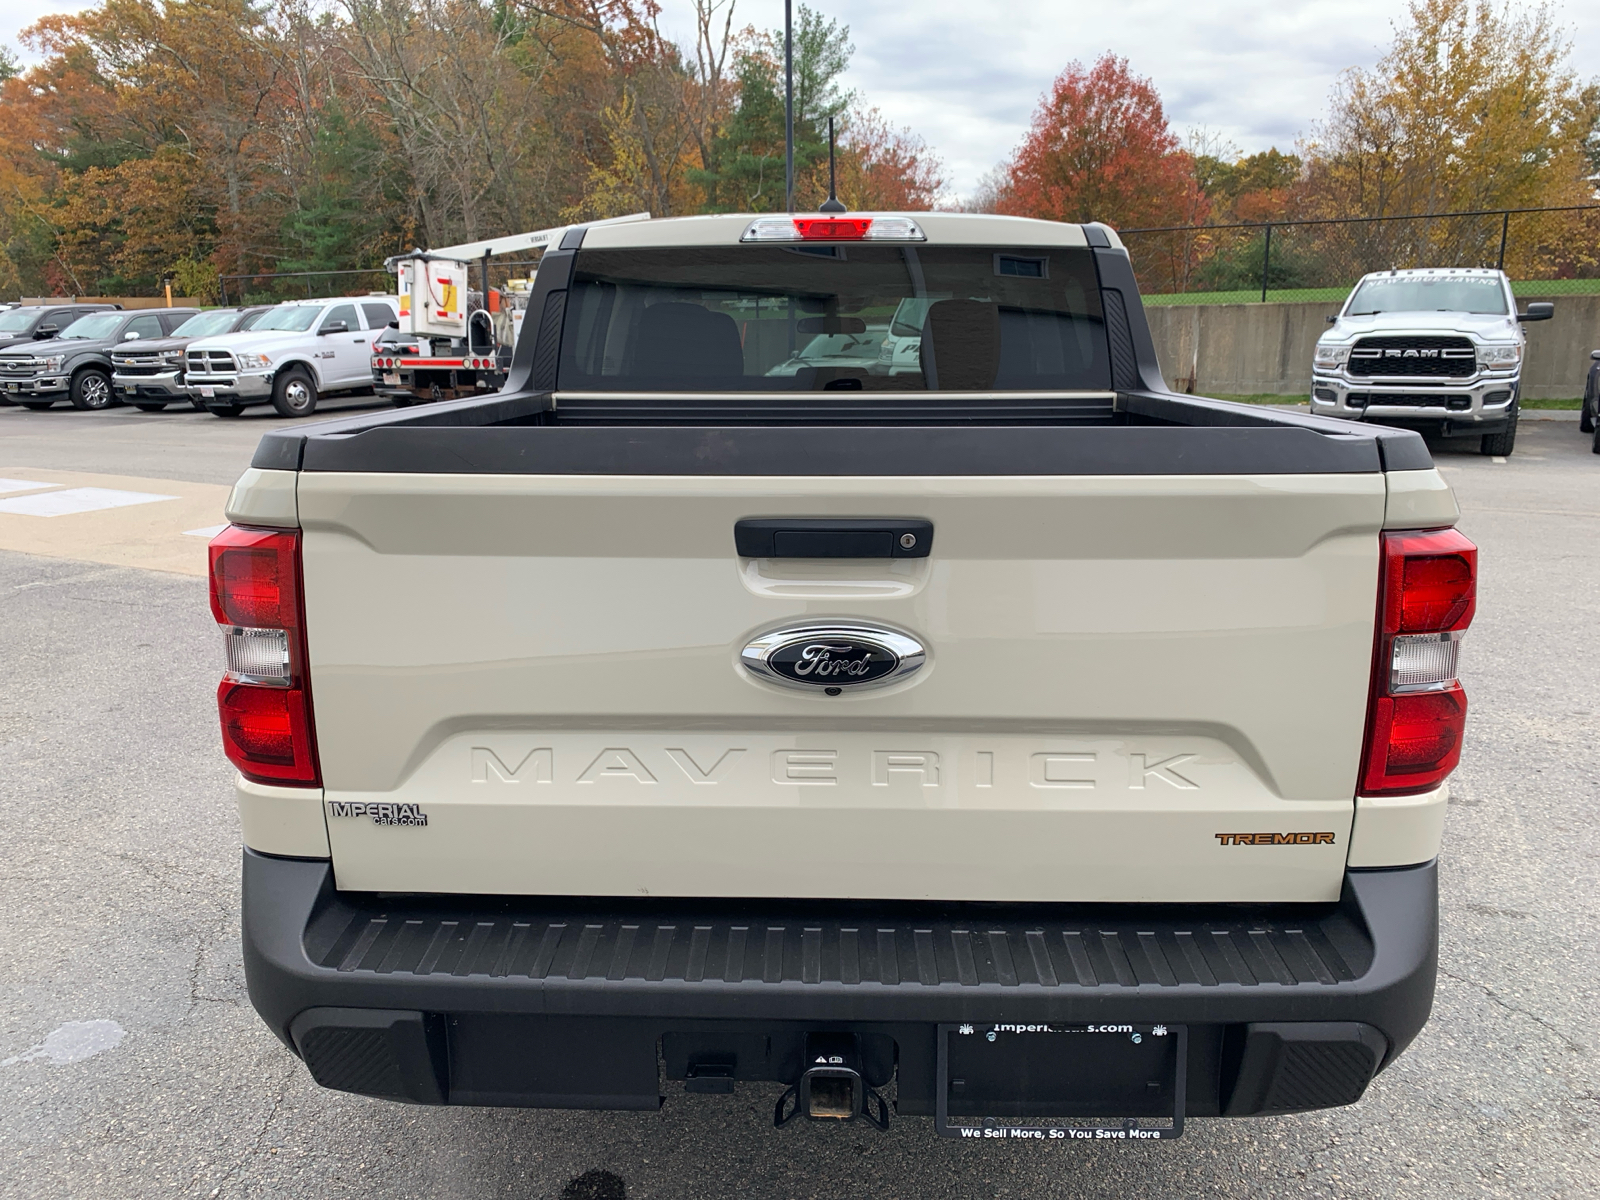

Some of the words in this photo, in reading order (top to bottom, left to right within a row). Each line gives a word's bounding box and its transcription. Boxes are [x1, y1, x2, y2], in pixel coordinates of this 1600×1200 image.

[1366, 278, 1401, 287] NEW
[1445, 276, 1498, 286] LAWNS
[1385, 349, 1438, 358] RAM
[794, 645, 871, 676] Ford
[470, 747, 1201, 789] MAVERICK
[328, 801, 427, 819] IMPERIAL
[373, 817, 428, 827] cars.com
[1215, 832, 1335, 845] TREMOR
[961, 1128, 981, 1138] We
[984, 1128, 1007, 1138] Sell
[1010, 1128, 1046, 1140] More,
[1049, 1129, 1065, 1139] So
[1069, 1129, 1092, 1139] You
[1096, 1129, 1125, 1139] Save
[1129, 1129, 1160, 1139] More
